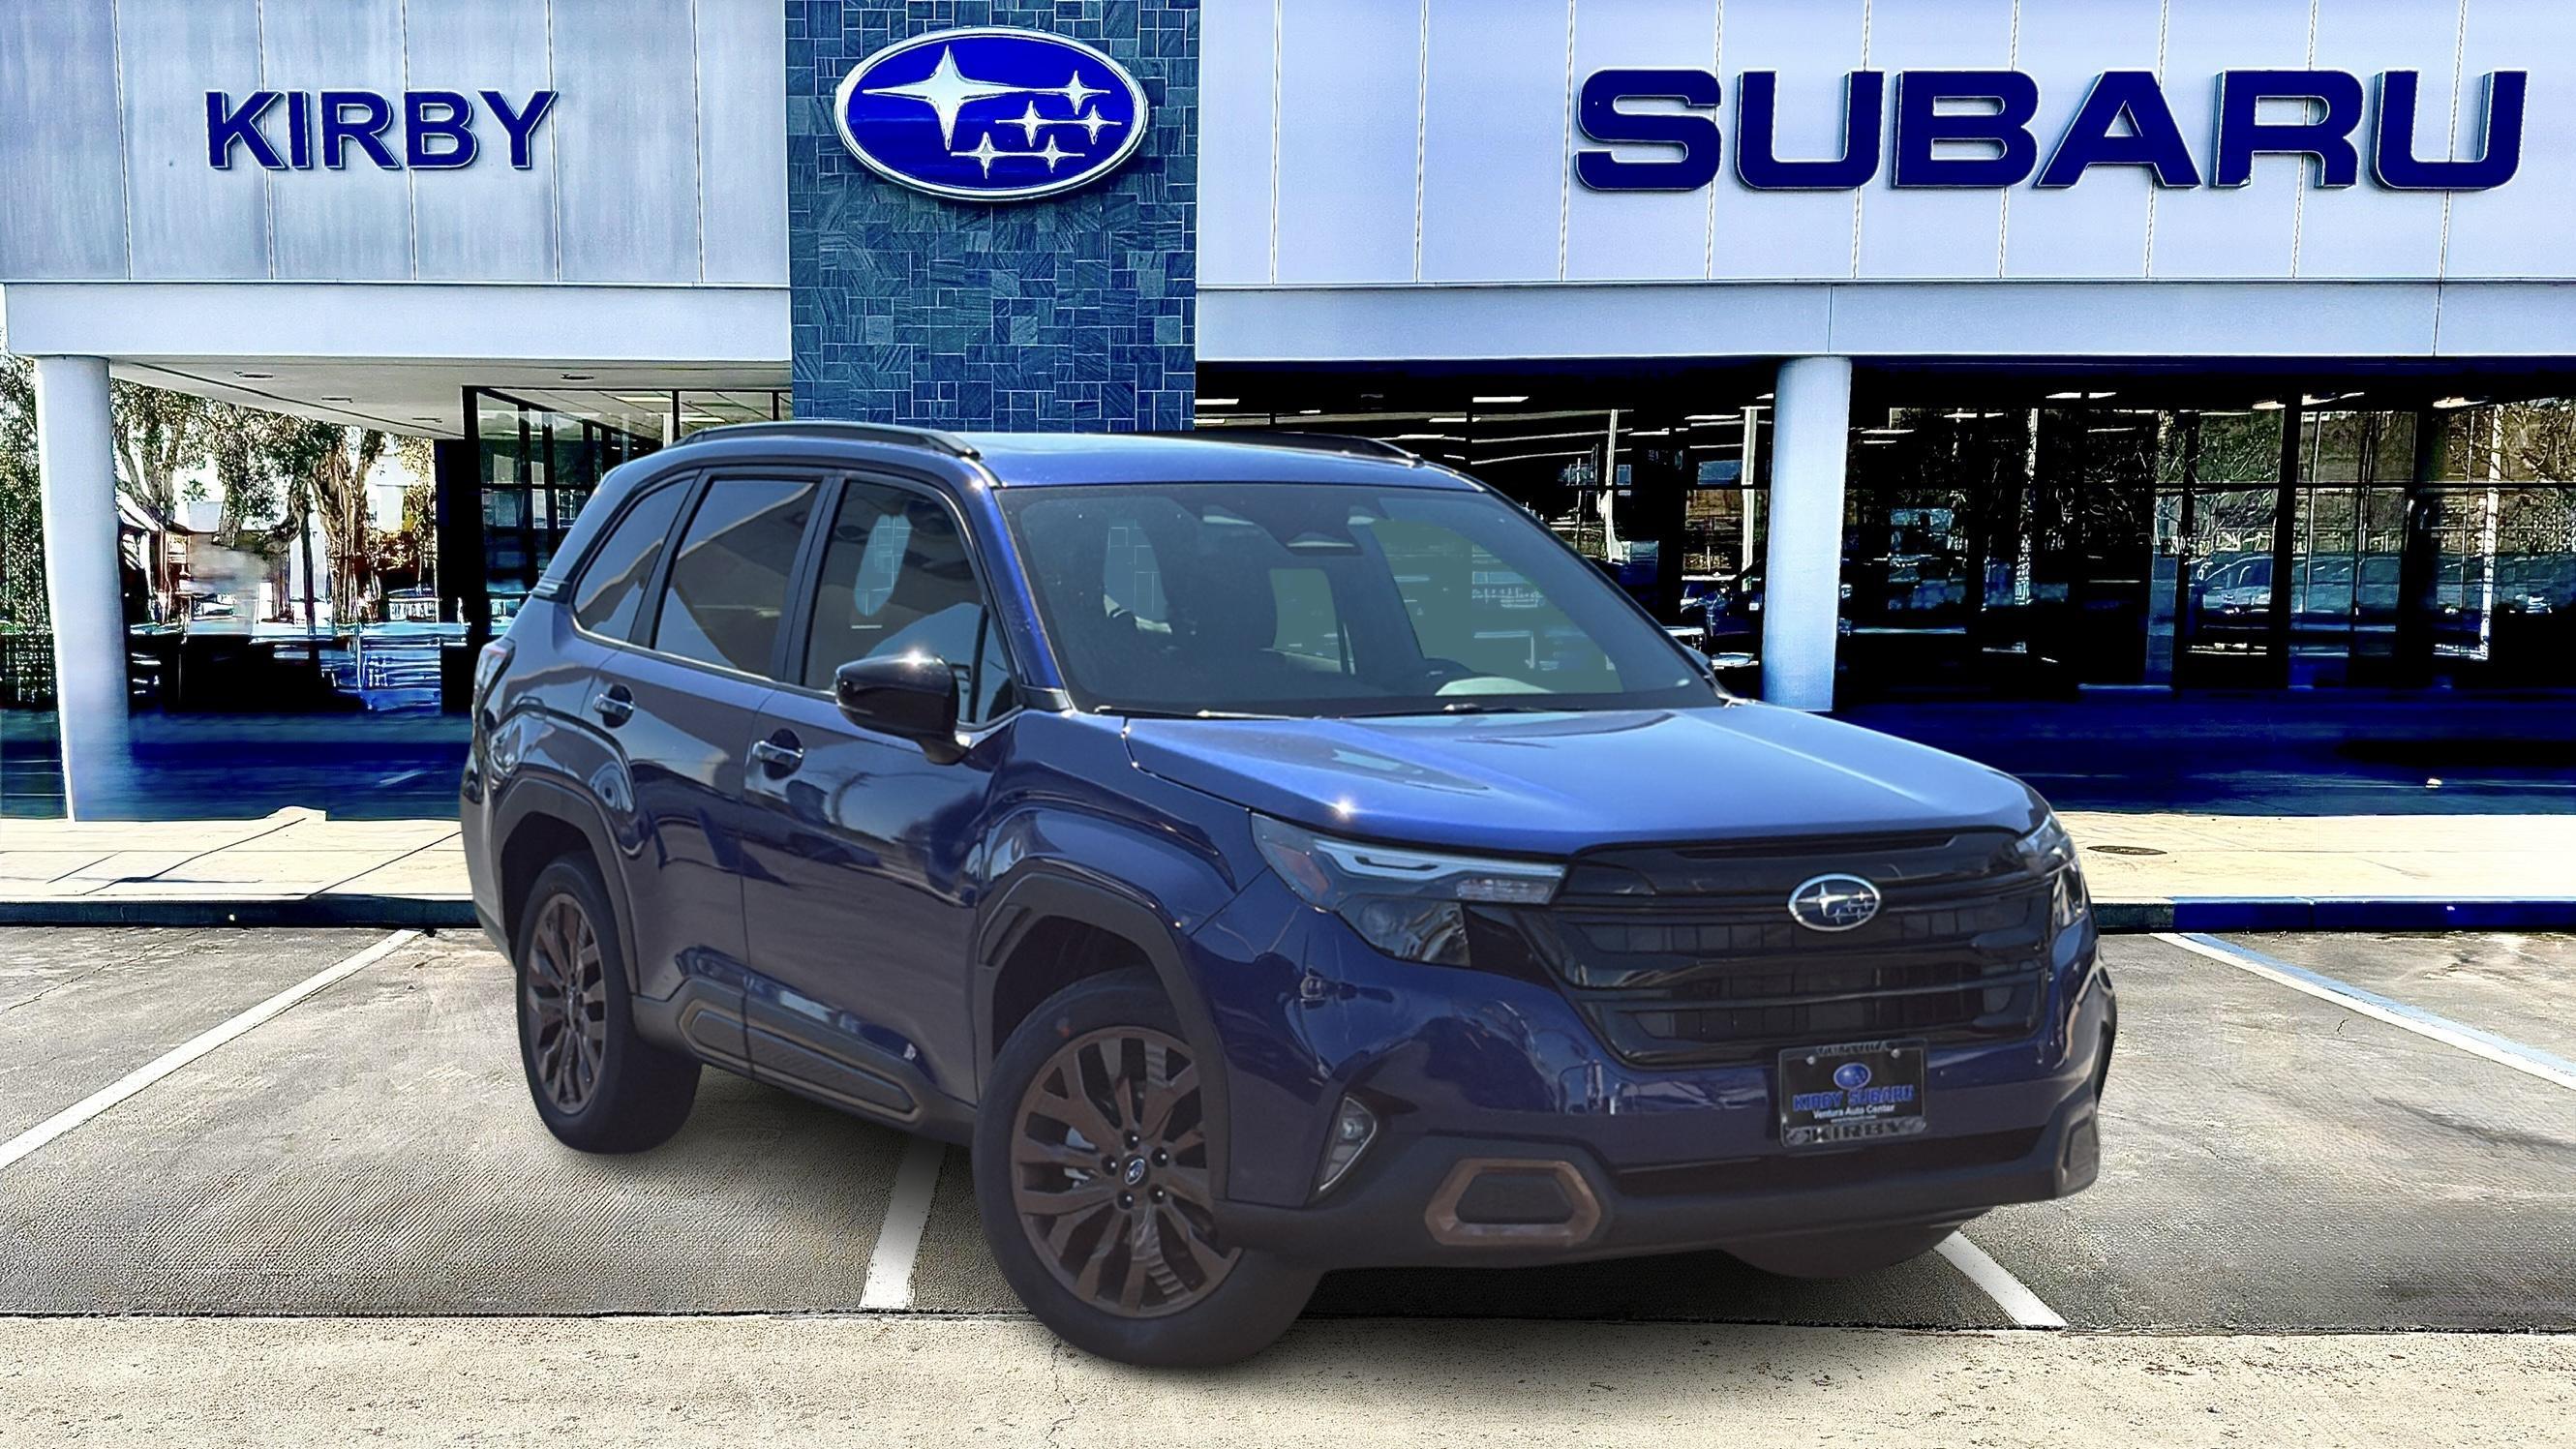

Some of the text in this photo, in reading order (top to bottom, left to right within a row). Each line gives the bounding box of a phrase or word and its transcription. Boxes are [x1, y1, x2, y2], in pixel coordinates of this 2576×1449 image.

[204, 89, 559, 170] KIRBY
[1575, 69, 2526, 193] SUBARU
[1793, 1085, 1914, 1111] KIRBY SUBARU
[1812, 1108, 1843, 1119] Ventura
[1845, 1106, 1864, 1116] Auto
[1866, 1103, 1895, 1114] Center
[1812, 1120, 1901, 1140] KIRBY
